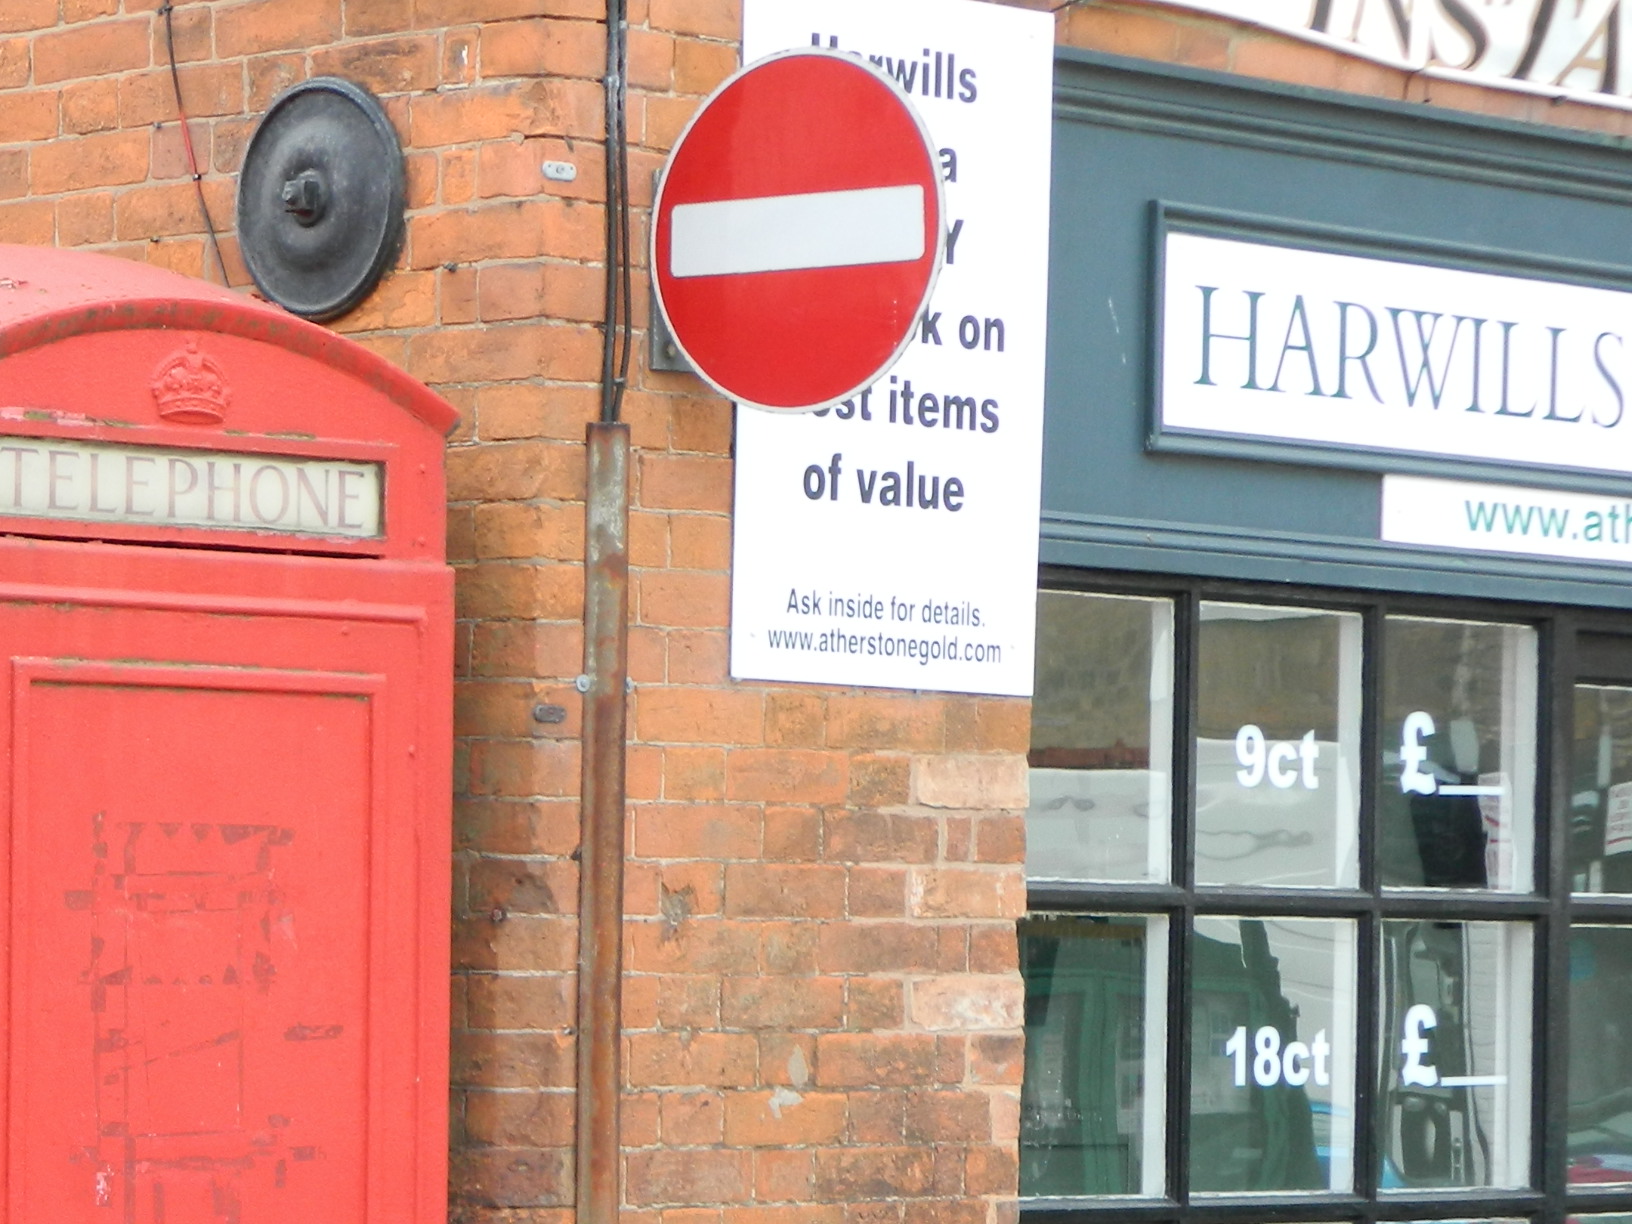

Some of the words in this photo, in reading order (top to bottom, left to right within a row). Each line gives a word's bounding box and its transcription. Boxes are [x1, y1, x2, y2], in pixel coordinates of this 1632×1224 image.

[959, 314, 1005, 352] on
[1192, 284, 1626, 430] HARWILLS
[889, 375, 1000, 434] items
[0, 446, 365, 530] TELEPHONE
[803, 453, 842, 501] of
[856, 460, 965, 512] value
[786, 588, 822, 616] Ask
[828, 590, 885, 621] inside
[890, 594, 916, 622] for
[921, 598, 986, 628] details.
[768, 627, 1002, 666] www.atherstonegold.com
[1235, 723, 1320, 790] 9ct
[1225, 1025, 1331, 1088] 18ct
